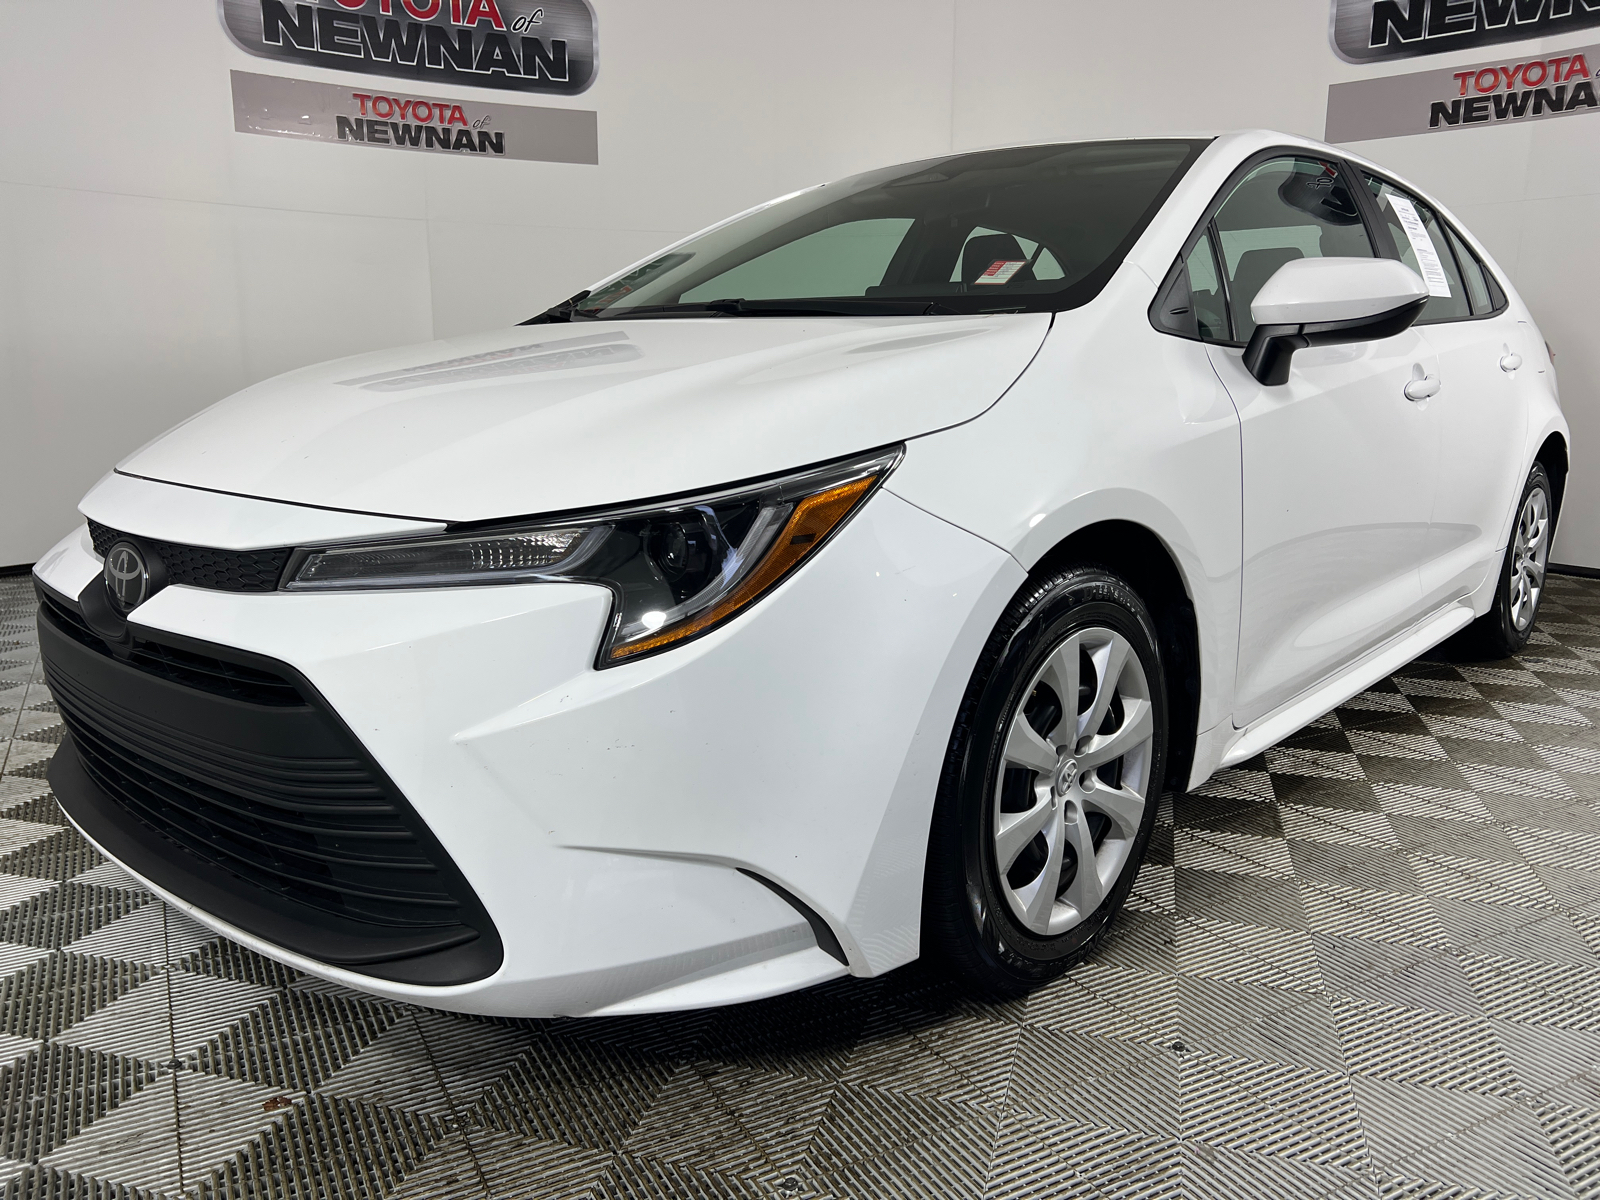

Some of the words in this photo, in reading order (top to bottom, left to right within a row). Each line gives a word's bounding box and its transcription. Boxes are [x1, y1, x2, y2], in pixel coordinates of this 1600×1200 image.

[261, 0, 569, 82] NEWNAN
[511, 9, 543, 33] of
[1453, 53, 1590, 96] TOYOTA
[352, 92, 468, 127] TOYOTA
[472, 115, 491, 130] of
[335, 115, 504, 155] NEWNAN
